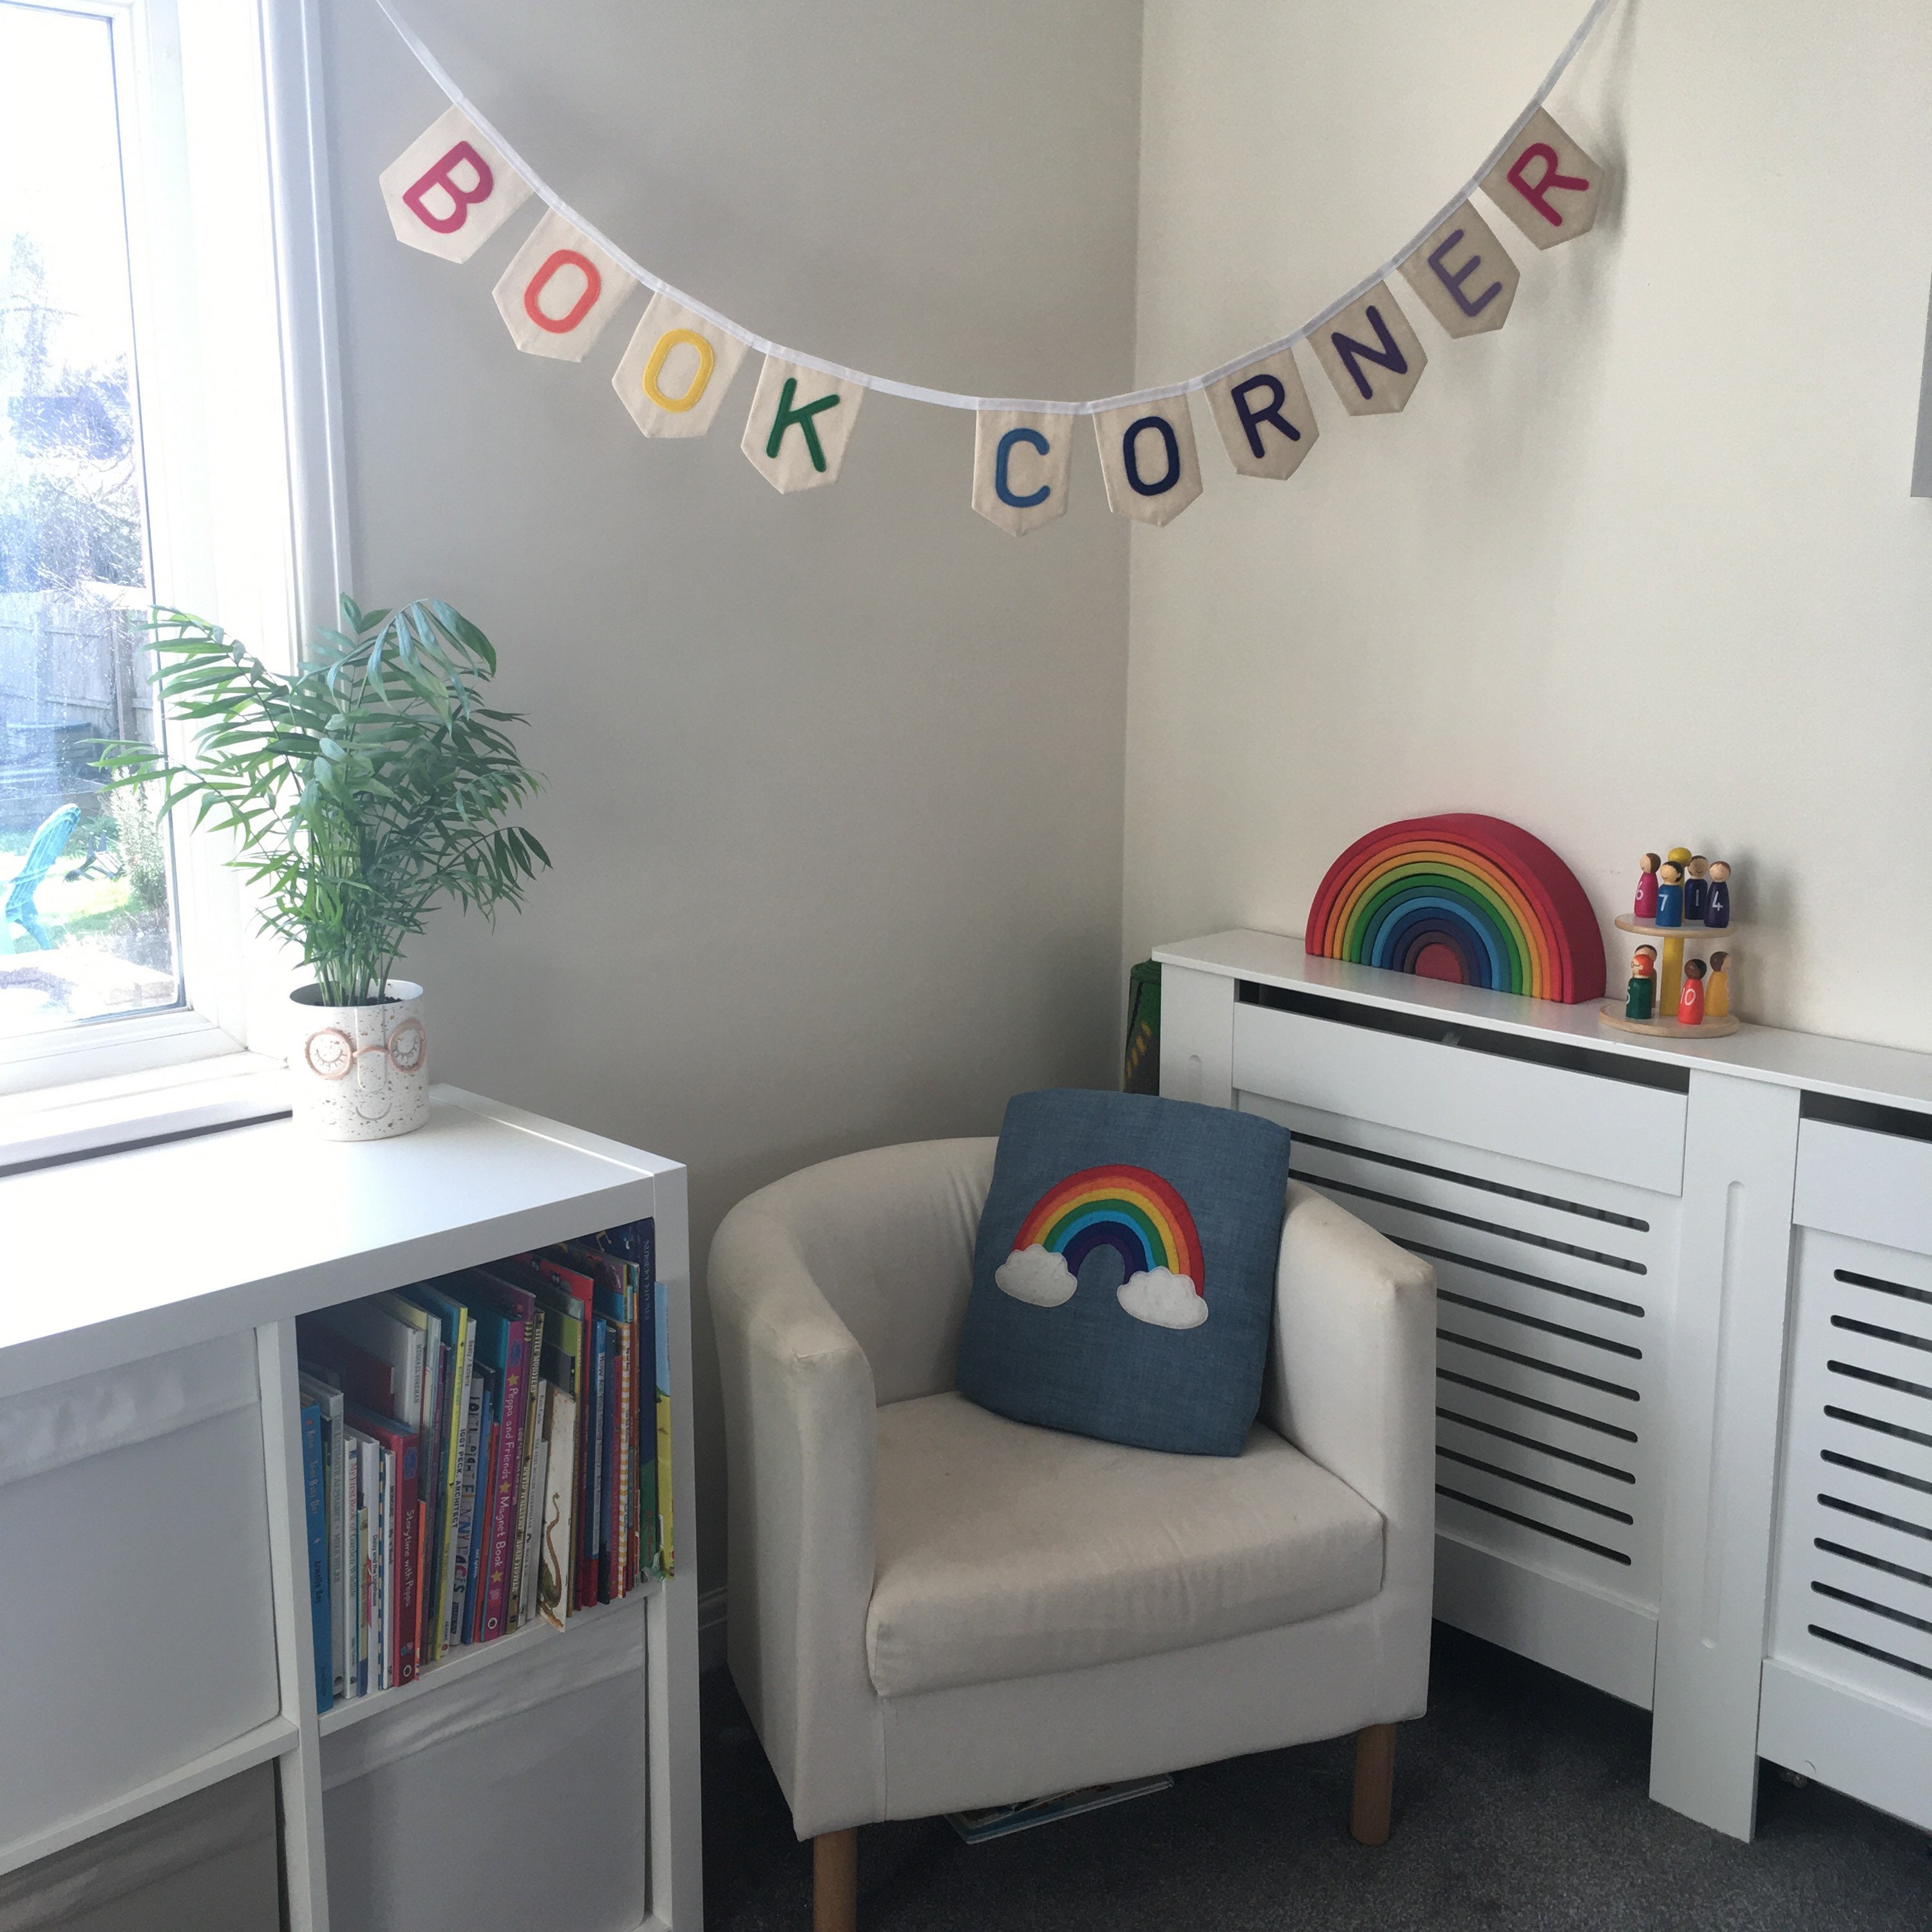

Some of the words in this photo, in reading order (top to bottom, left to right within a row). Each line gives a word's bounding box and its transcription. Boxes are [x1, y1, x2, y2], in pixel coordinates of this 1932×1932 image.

[401, 140, 840, 473] BOOK
[995, 142, 1589, 509] CORNER
[1636, 881, 1643, 900] 6
[1658, 894, 1669, 911] 7
[1712, 891, 1724, 911] 4
[1680, 987, 1696, 1006] 10
[464, 1363, 473, 1387] Roberts
[505, 1387, 518, 1417] Peppa
[458, 1428, 466, 1448] IGGY
[506, 1420, 515, 1439] and
[502, 1441, 515, 1480] Friends
[452, 1480, 462, 1528] ARCHITECT
[495, 1496, 510, 1536] Magnet
[403, 1509, 415, 1557] Storytime
[494, 1541, 507, 1567] Book
[404, 1559, 413, 1580] with
[402, 1580, 414, 1607] Peppa
